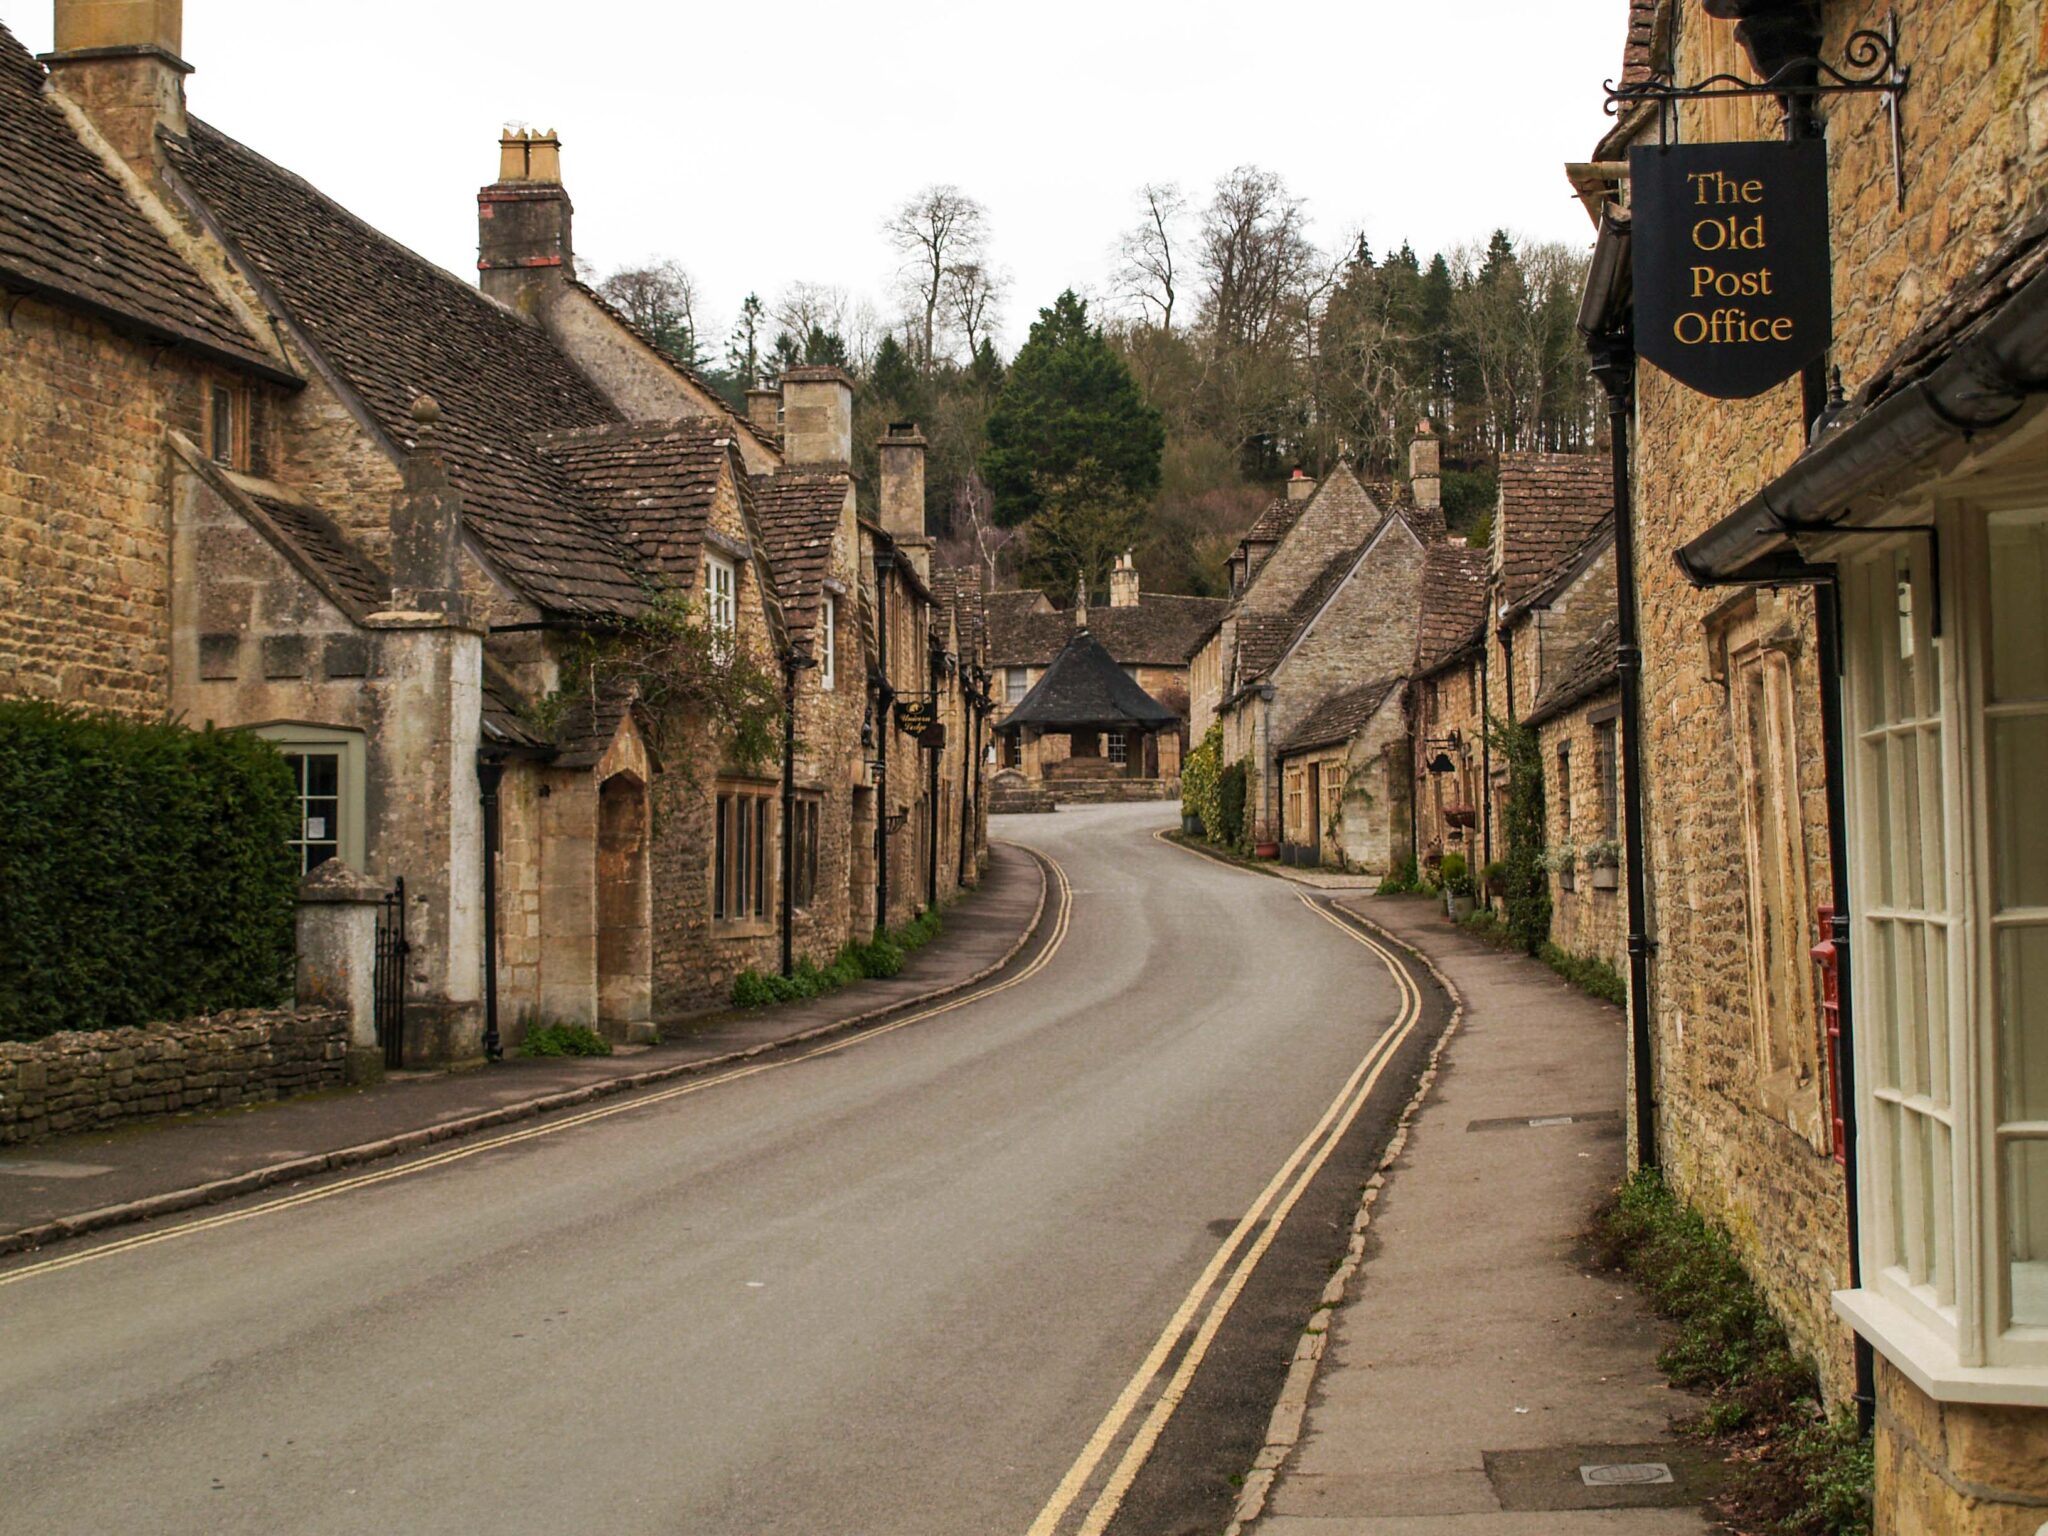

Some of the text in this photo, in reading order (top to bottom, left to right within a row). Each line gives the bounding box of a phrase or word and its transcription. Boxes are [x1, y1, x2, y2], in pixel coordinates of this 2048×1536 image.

[1687, 171, 1764, 205] The
[1692, 215, 1766, 251] Old
[1690, 266, 1773, 298] Post
[1673, 308, 1793, 344] Office
